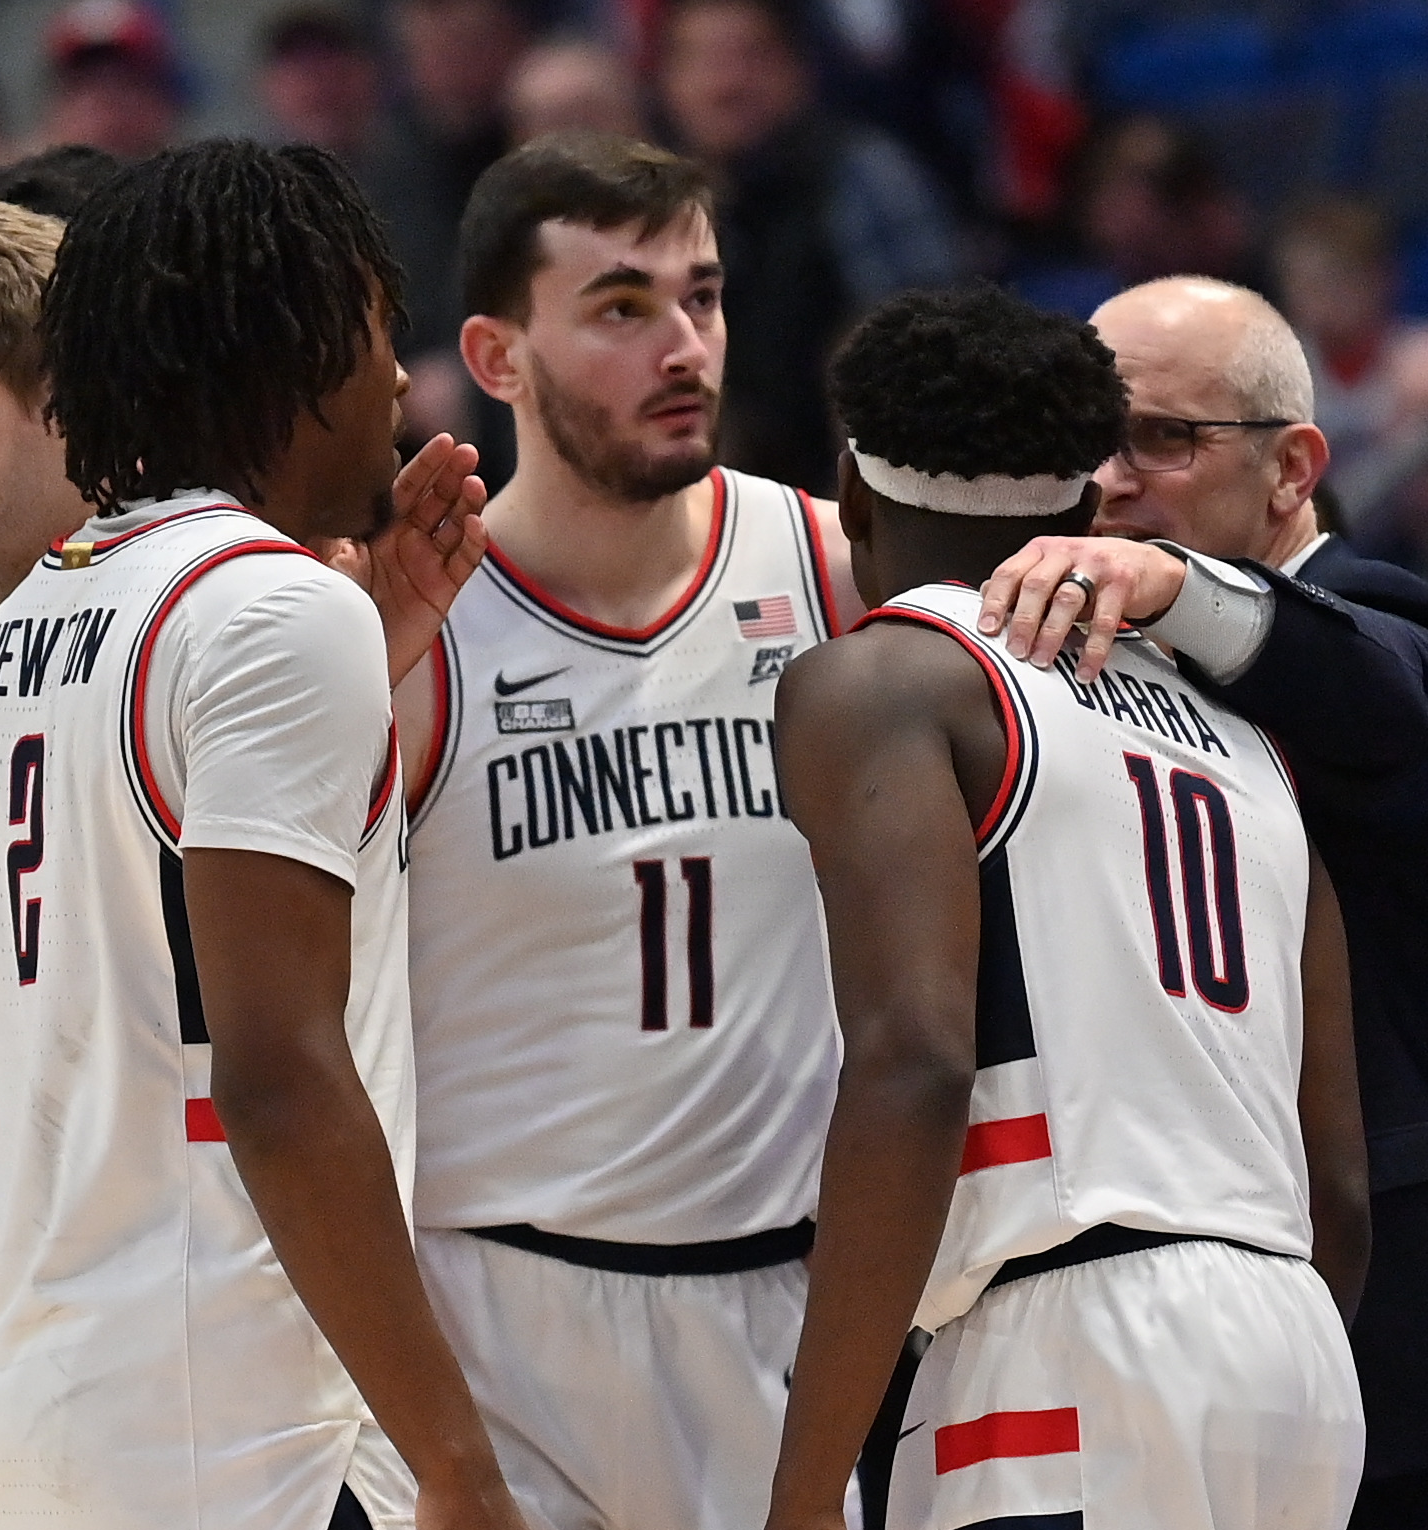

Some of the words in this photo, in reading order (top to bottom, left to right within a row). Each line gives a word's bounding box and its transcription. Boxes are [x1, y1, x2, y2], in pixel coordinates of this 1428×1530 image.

[7, 733, 44, 986] 2
[487, 718, 790, 861] CONNECTIC
[1122, 750, 1250, 1014] 10
[633, 856, 714, 1031] 11
